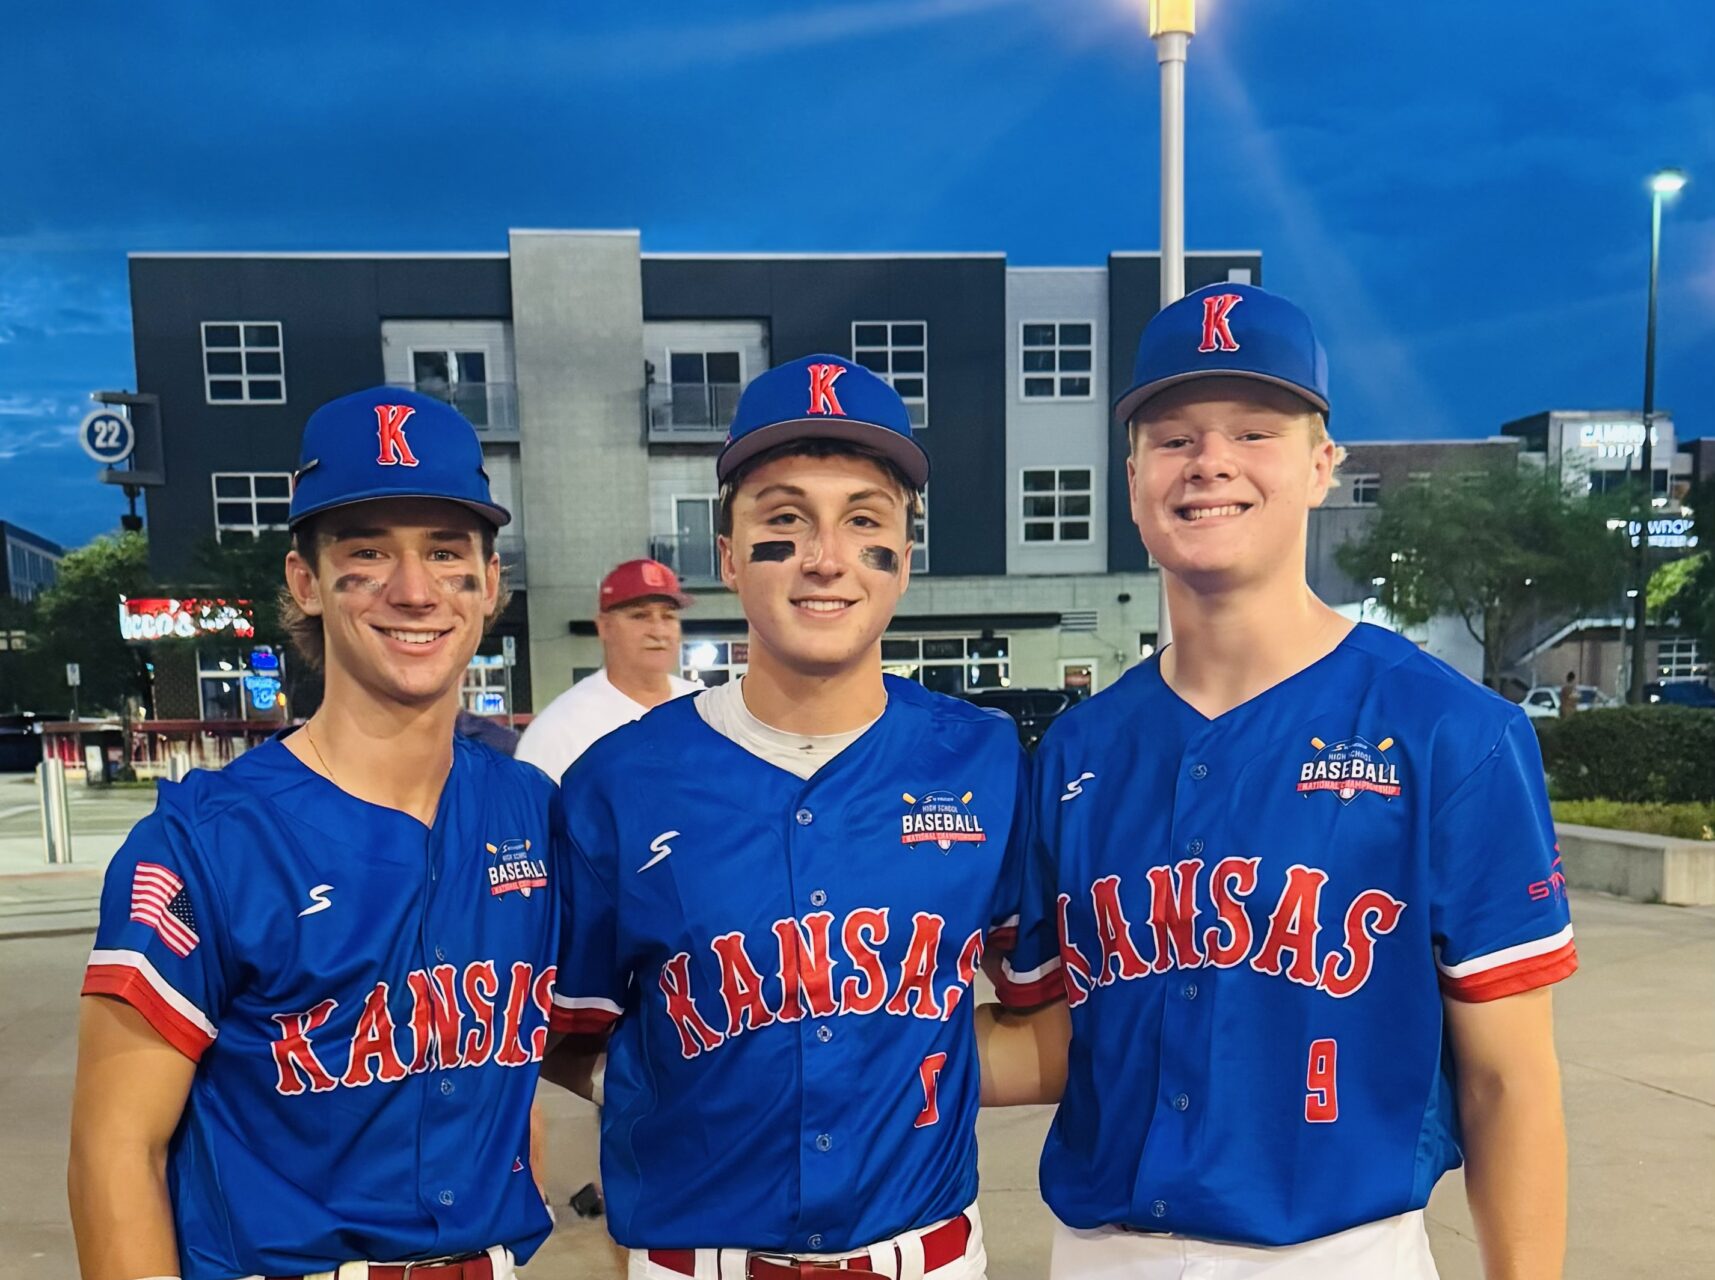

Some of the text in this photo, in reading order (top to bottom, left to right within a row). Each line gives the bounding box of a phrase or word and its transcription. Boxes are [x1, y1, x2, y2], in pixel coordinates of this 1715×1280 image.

[1198, 293, 1243, 353] K
[807, 363, 847, 416] K
[94, 420, 121, 448] 22
[374, 404, 420, 467] K
[1301, 759, 1399, 784] BASEBALL
[902, 813, 983, 833] BASEBALL
[1304, 1038, 1339, 1123] 9
